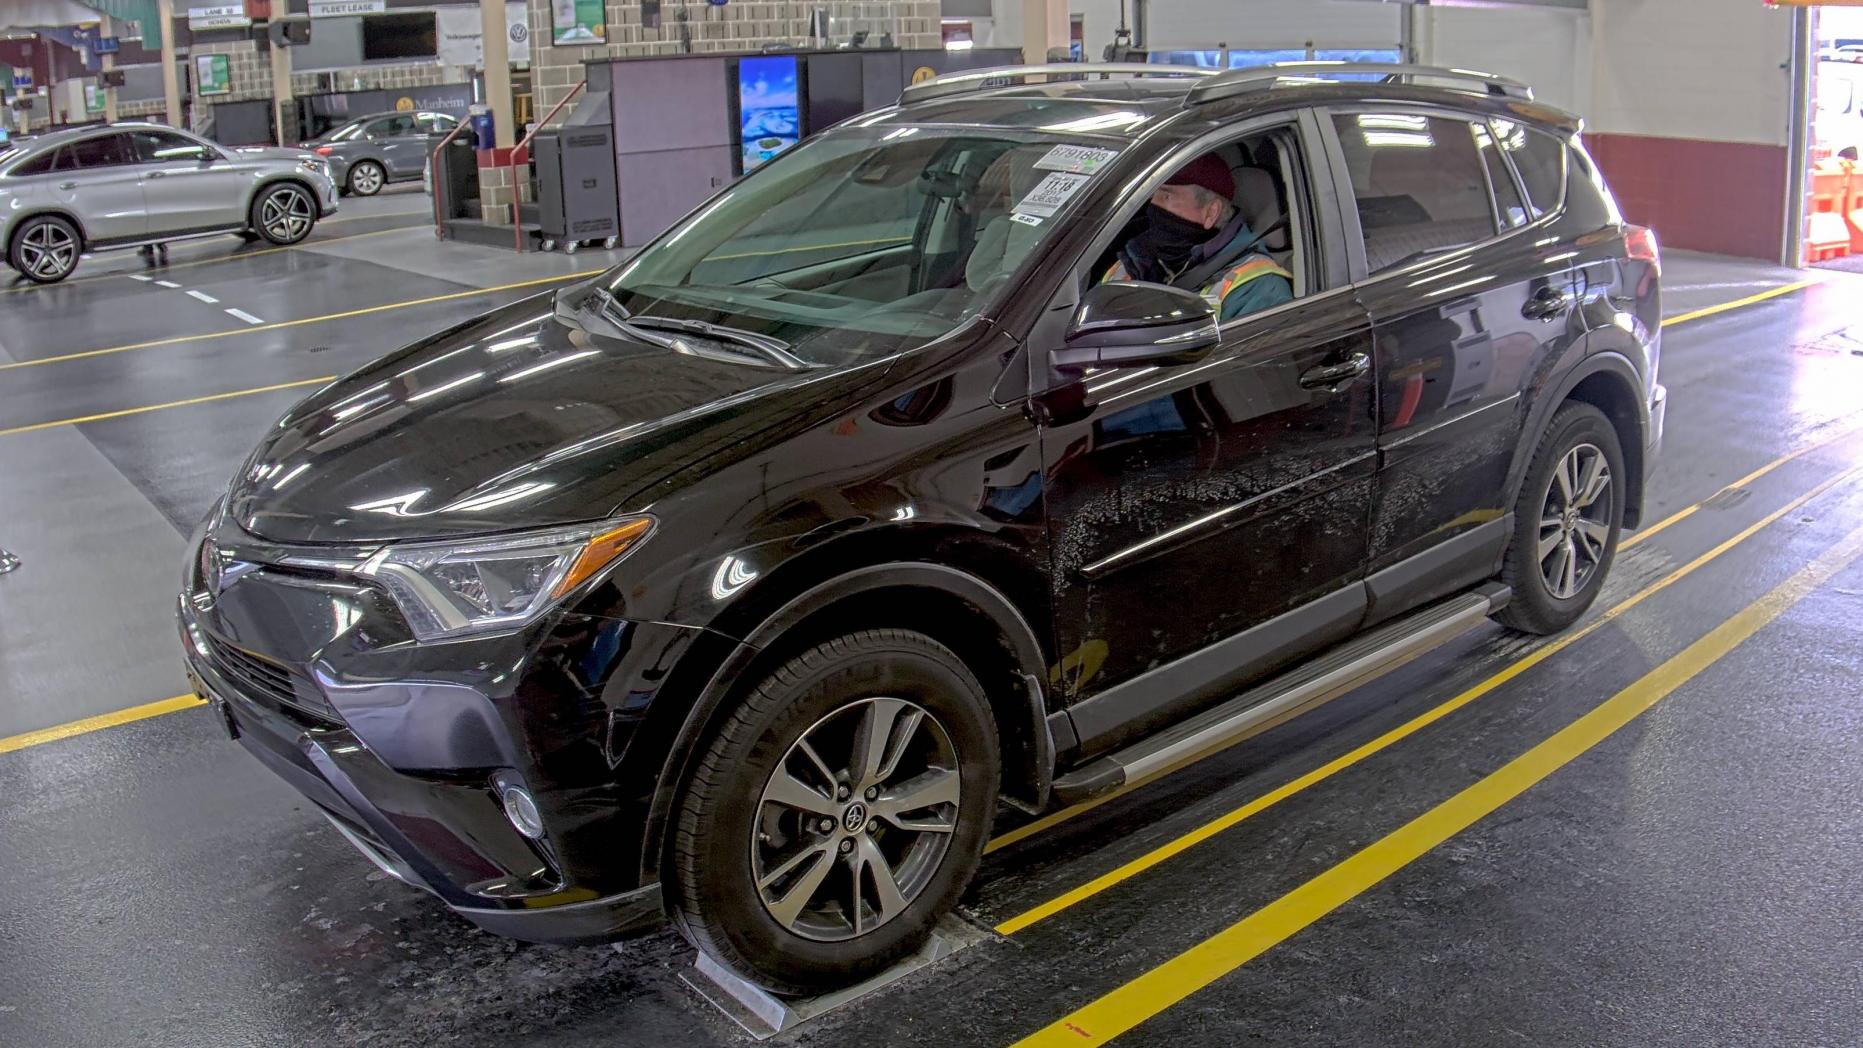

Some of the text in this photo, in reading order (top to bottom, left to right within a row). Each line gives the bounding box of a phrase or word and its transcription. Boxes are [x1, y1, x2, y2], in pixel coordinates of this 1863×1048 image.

[204, 8, 222, 16] LANE
[321, 3, 374, 14] FLEET LEASE
[415, 97, 465, 110] Manheim
[1050, 147, 1108, 162] 6791803
[1044, 180, 1075, 192] 11:18
